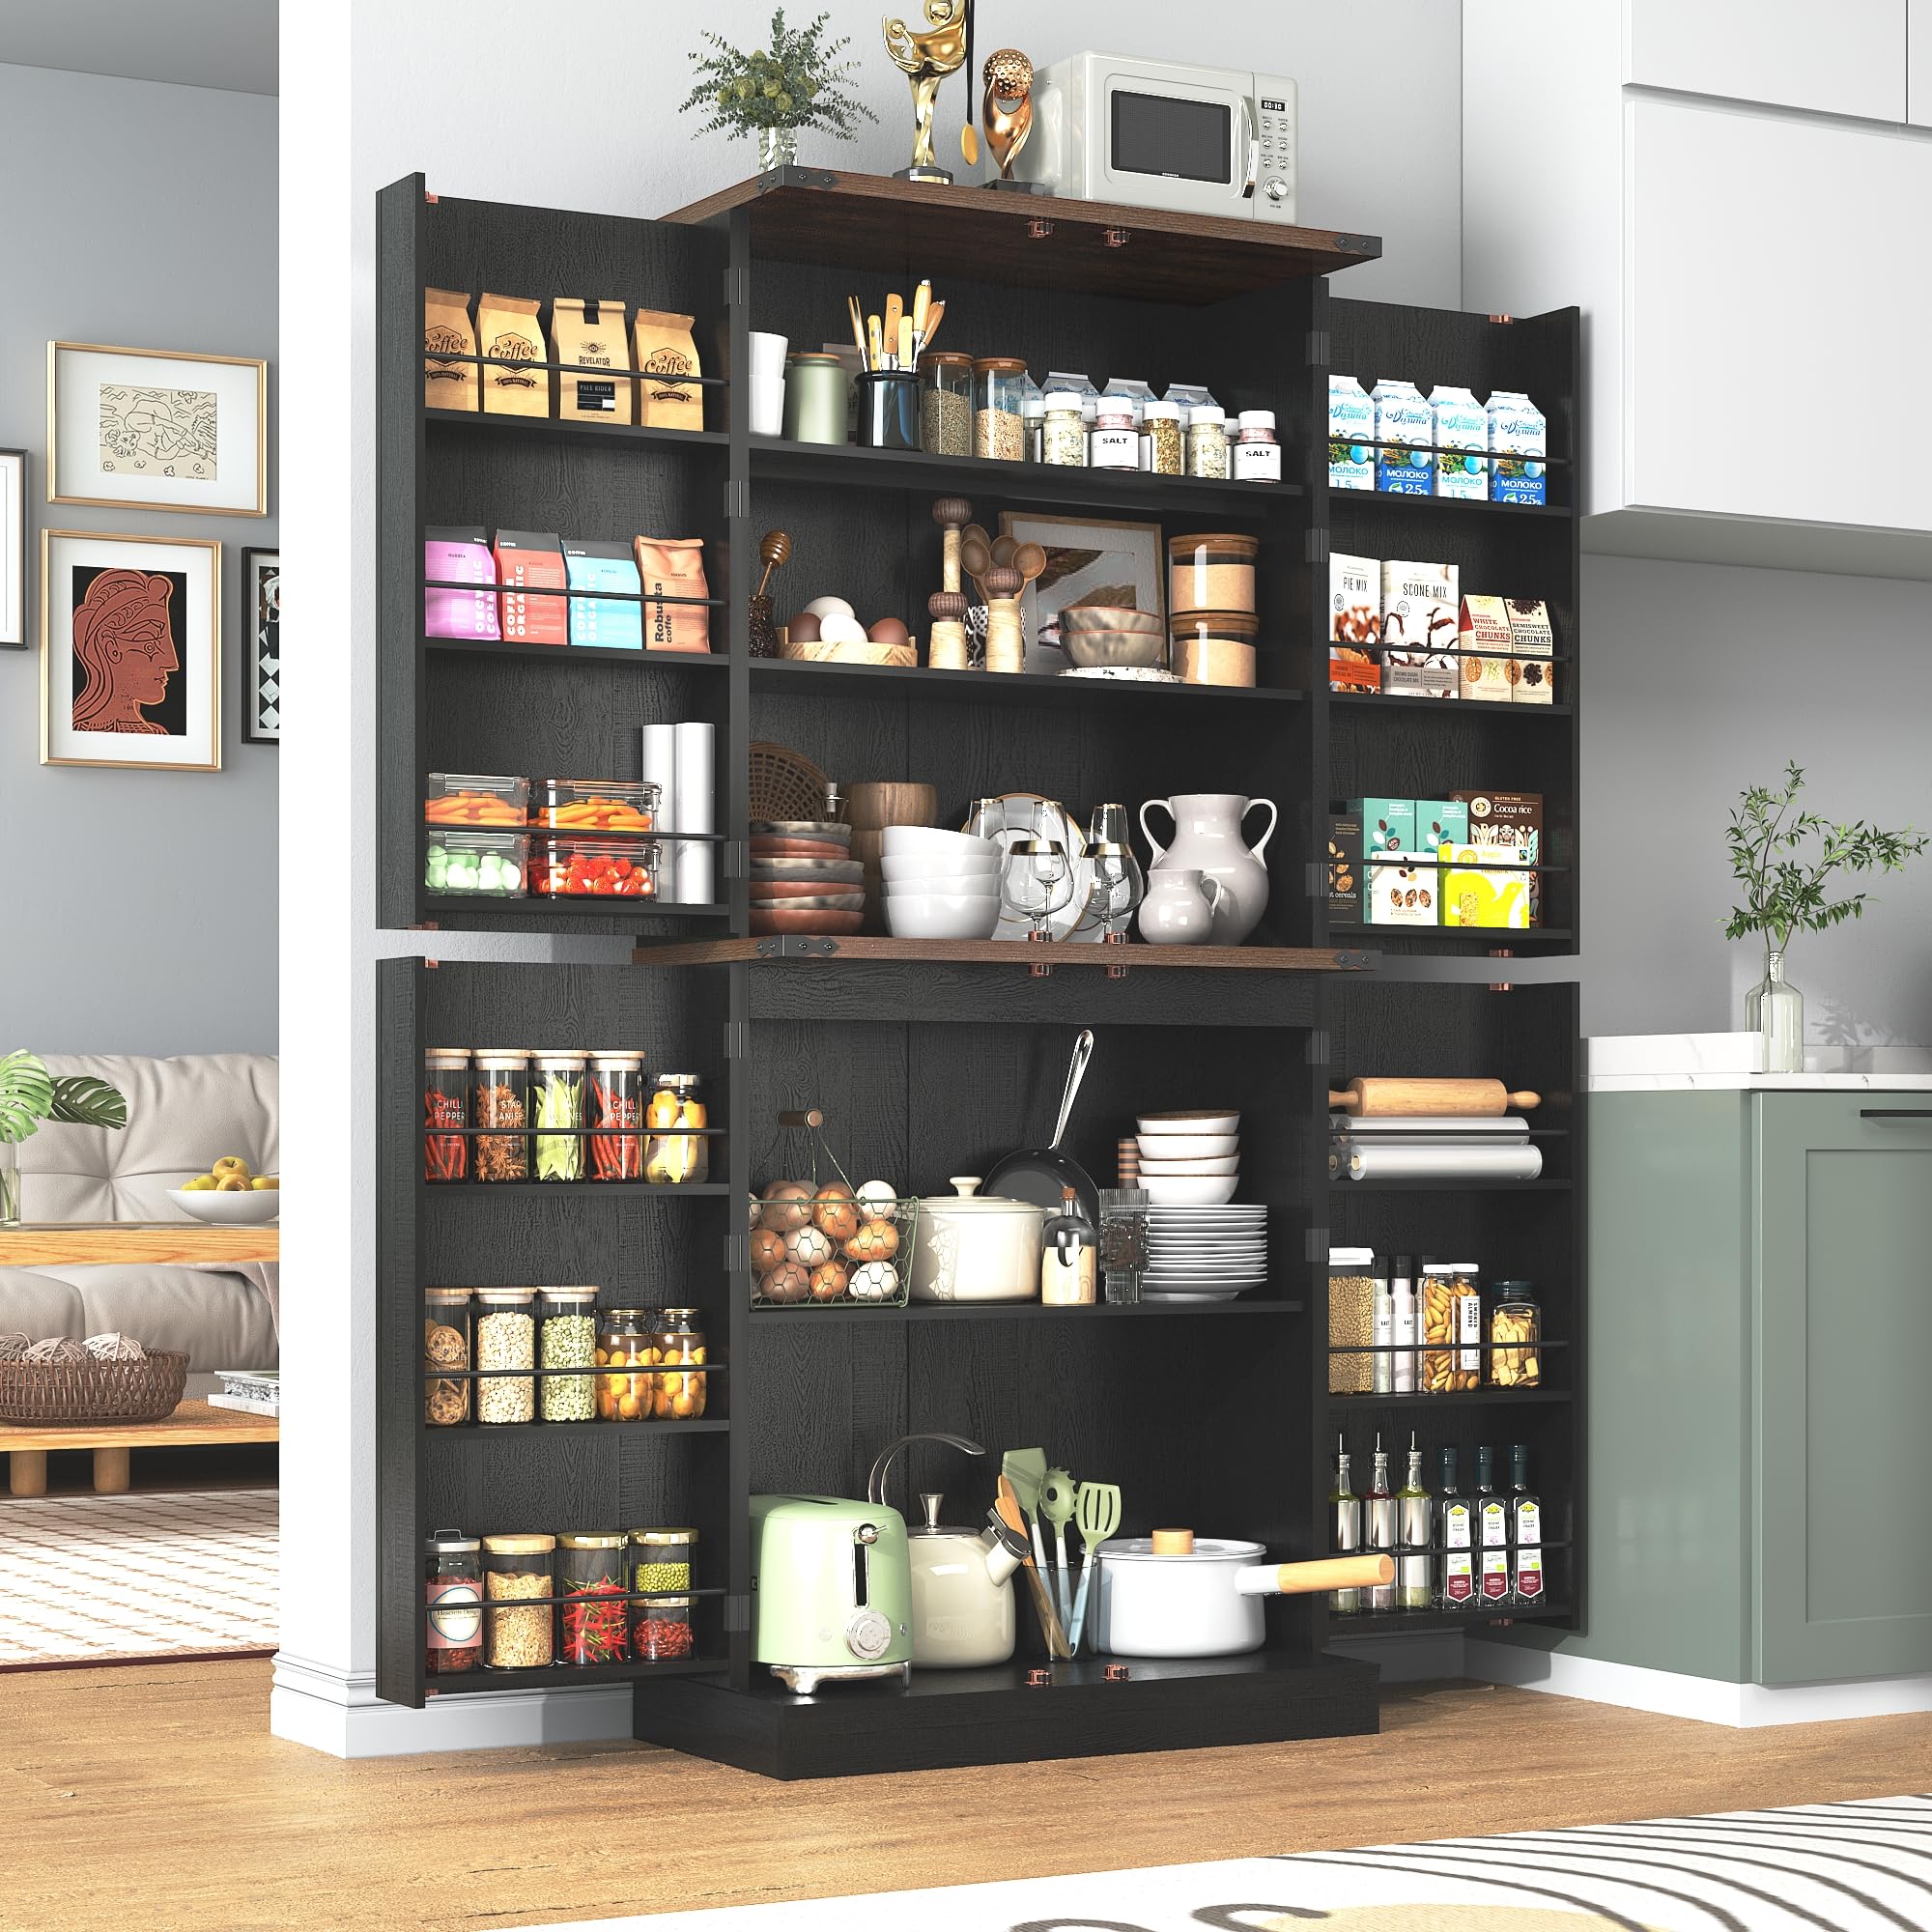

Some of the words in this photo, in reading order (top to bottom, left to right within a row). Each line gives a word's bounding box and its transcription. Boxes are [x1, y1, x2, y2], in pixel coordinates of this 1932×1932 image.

[424, 332, 468, 355] offee
[488, 340, 538, 360] Coffee
[579, 355, 611, 367] REVELATOR
[644, 355, 693, 375] Coffee
[1329, 466, 1369, 475] МОЛОКО
[1386, 469, 1429, 480] МОЛОКО
[1442, 476, 1483, 486] МОЛОКО
[1501, 479, 1543, 490] МОЛОКО
[1343, 577, 1353, 591] PIE
[1355, 579, 1368, 592] MIX
[1403, 582, 1430, 598] SCONE
[1433, 585, 1447, 599] MIX
[1475, 631, 1511, 640] CHUNKS
[1514, 635, 1551, 643] CHUNKS
[1493, 803, 1518, 813] Cocoa
[1519, 805, 1533, 814] rice
[434, 1111, 465, 1121] PEPPER
[498, 1112, 526, 1121] ANISE
